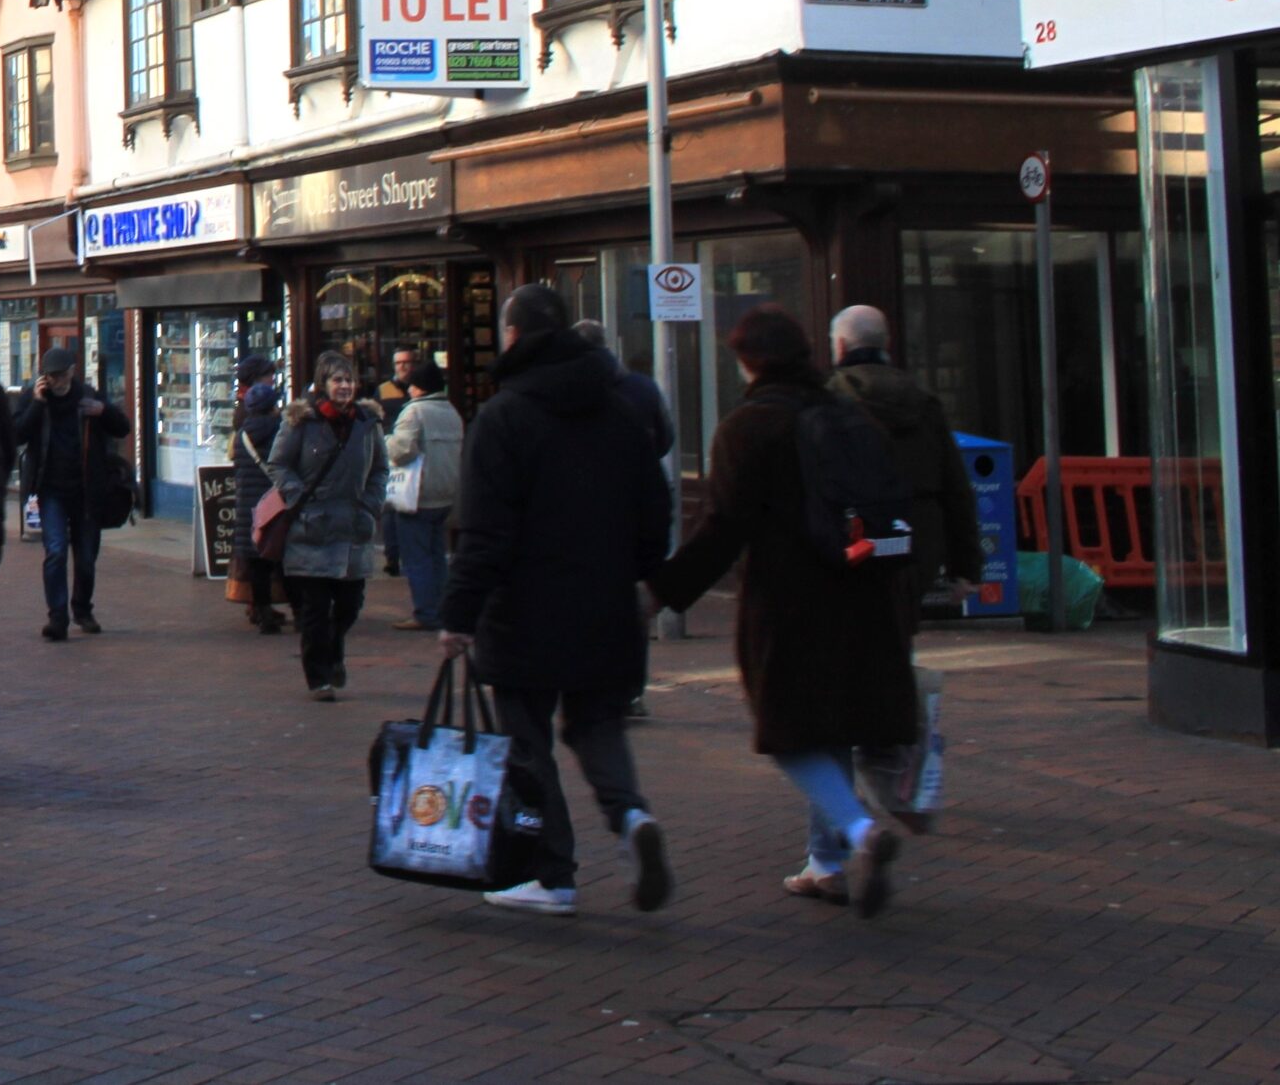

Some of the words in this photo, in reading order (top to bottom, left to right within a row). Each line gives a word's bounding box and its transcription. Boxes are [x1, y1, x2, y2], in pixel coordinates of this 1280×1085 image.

[375, 42, 431, 55] ROCHE
[1035, 20, 1057, 44] 28
[339, 180, 380, 212] Sweet
[382, 170, 438, 211] Shoppe
[161, 199, 201, 241] SHOP
